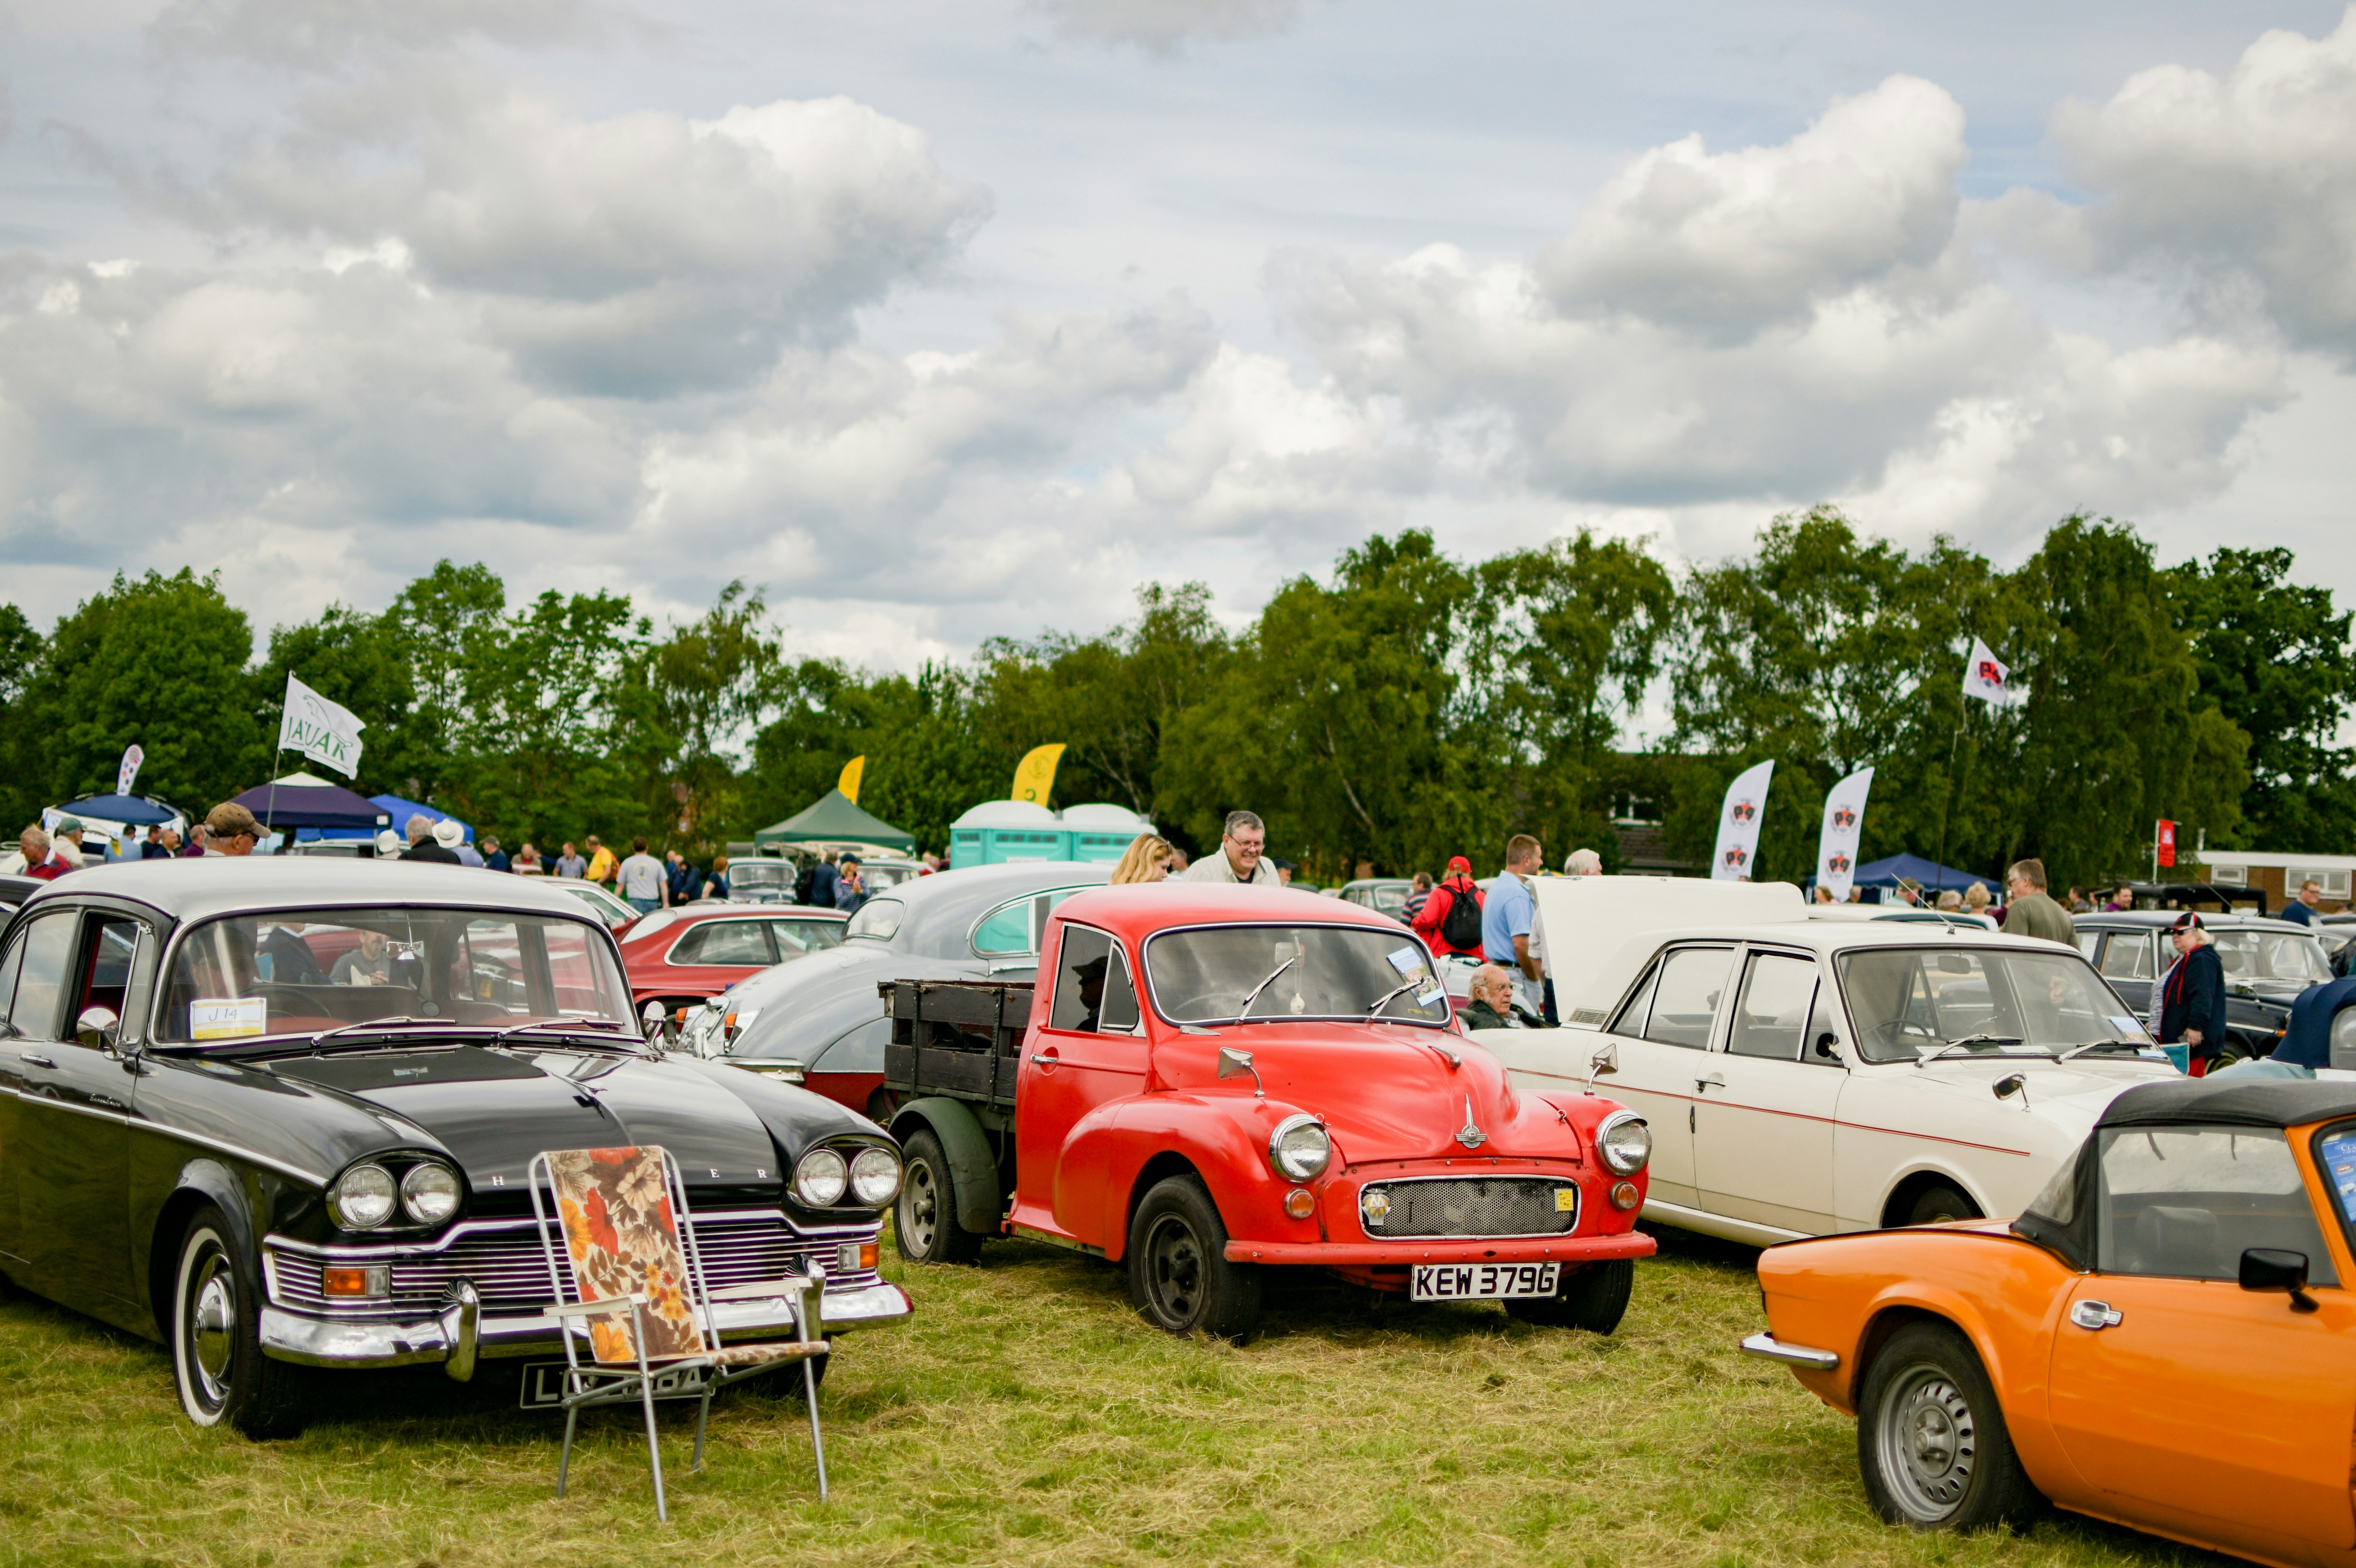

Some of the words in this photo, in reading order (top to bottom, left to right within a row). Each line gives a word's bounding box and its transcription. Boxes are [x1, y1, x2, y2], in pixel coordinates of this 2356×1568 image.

[285, 716, 344, 761] JAUA
[209, 1007, 219, 1021] J
[224, 1007, 238, 1020] 14
[1416, 1267, 1473, 1296] KEW
[1479, 1266, 1556, 1294] 379G
